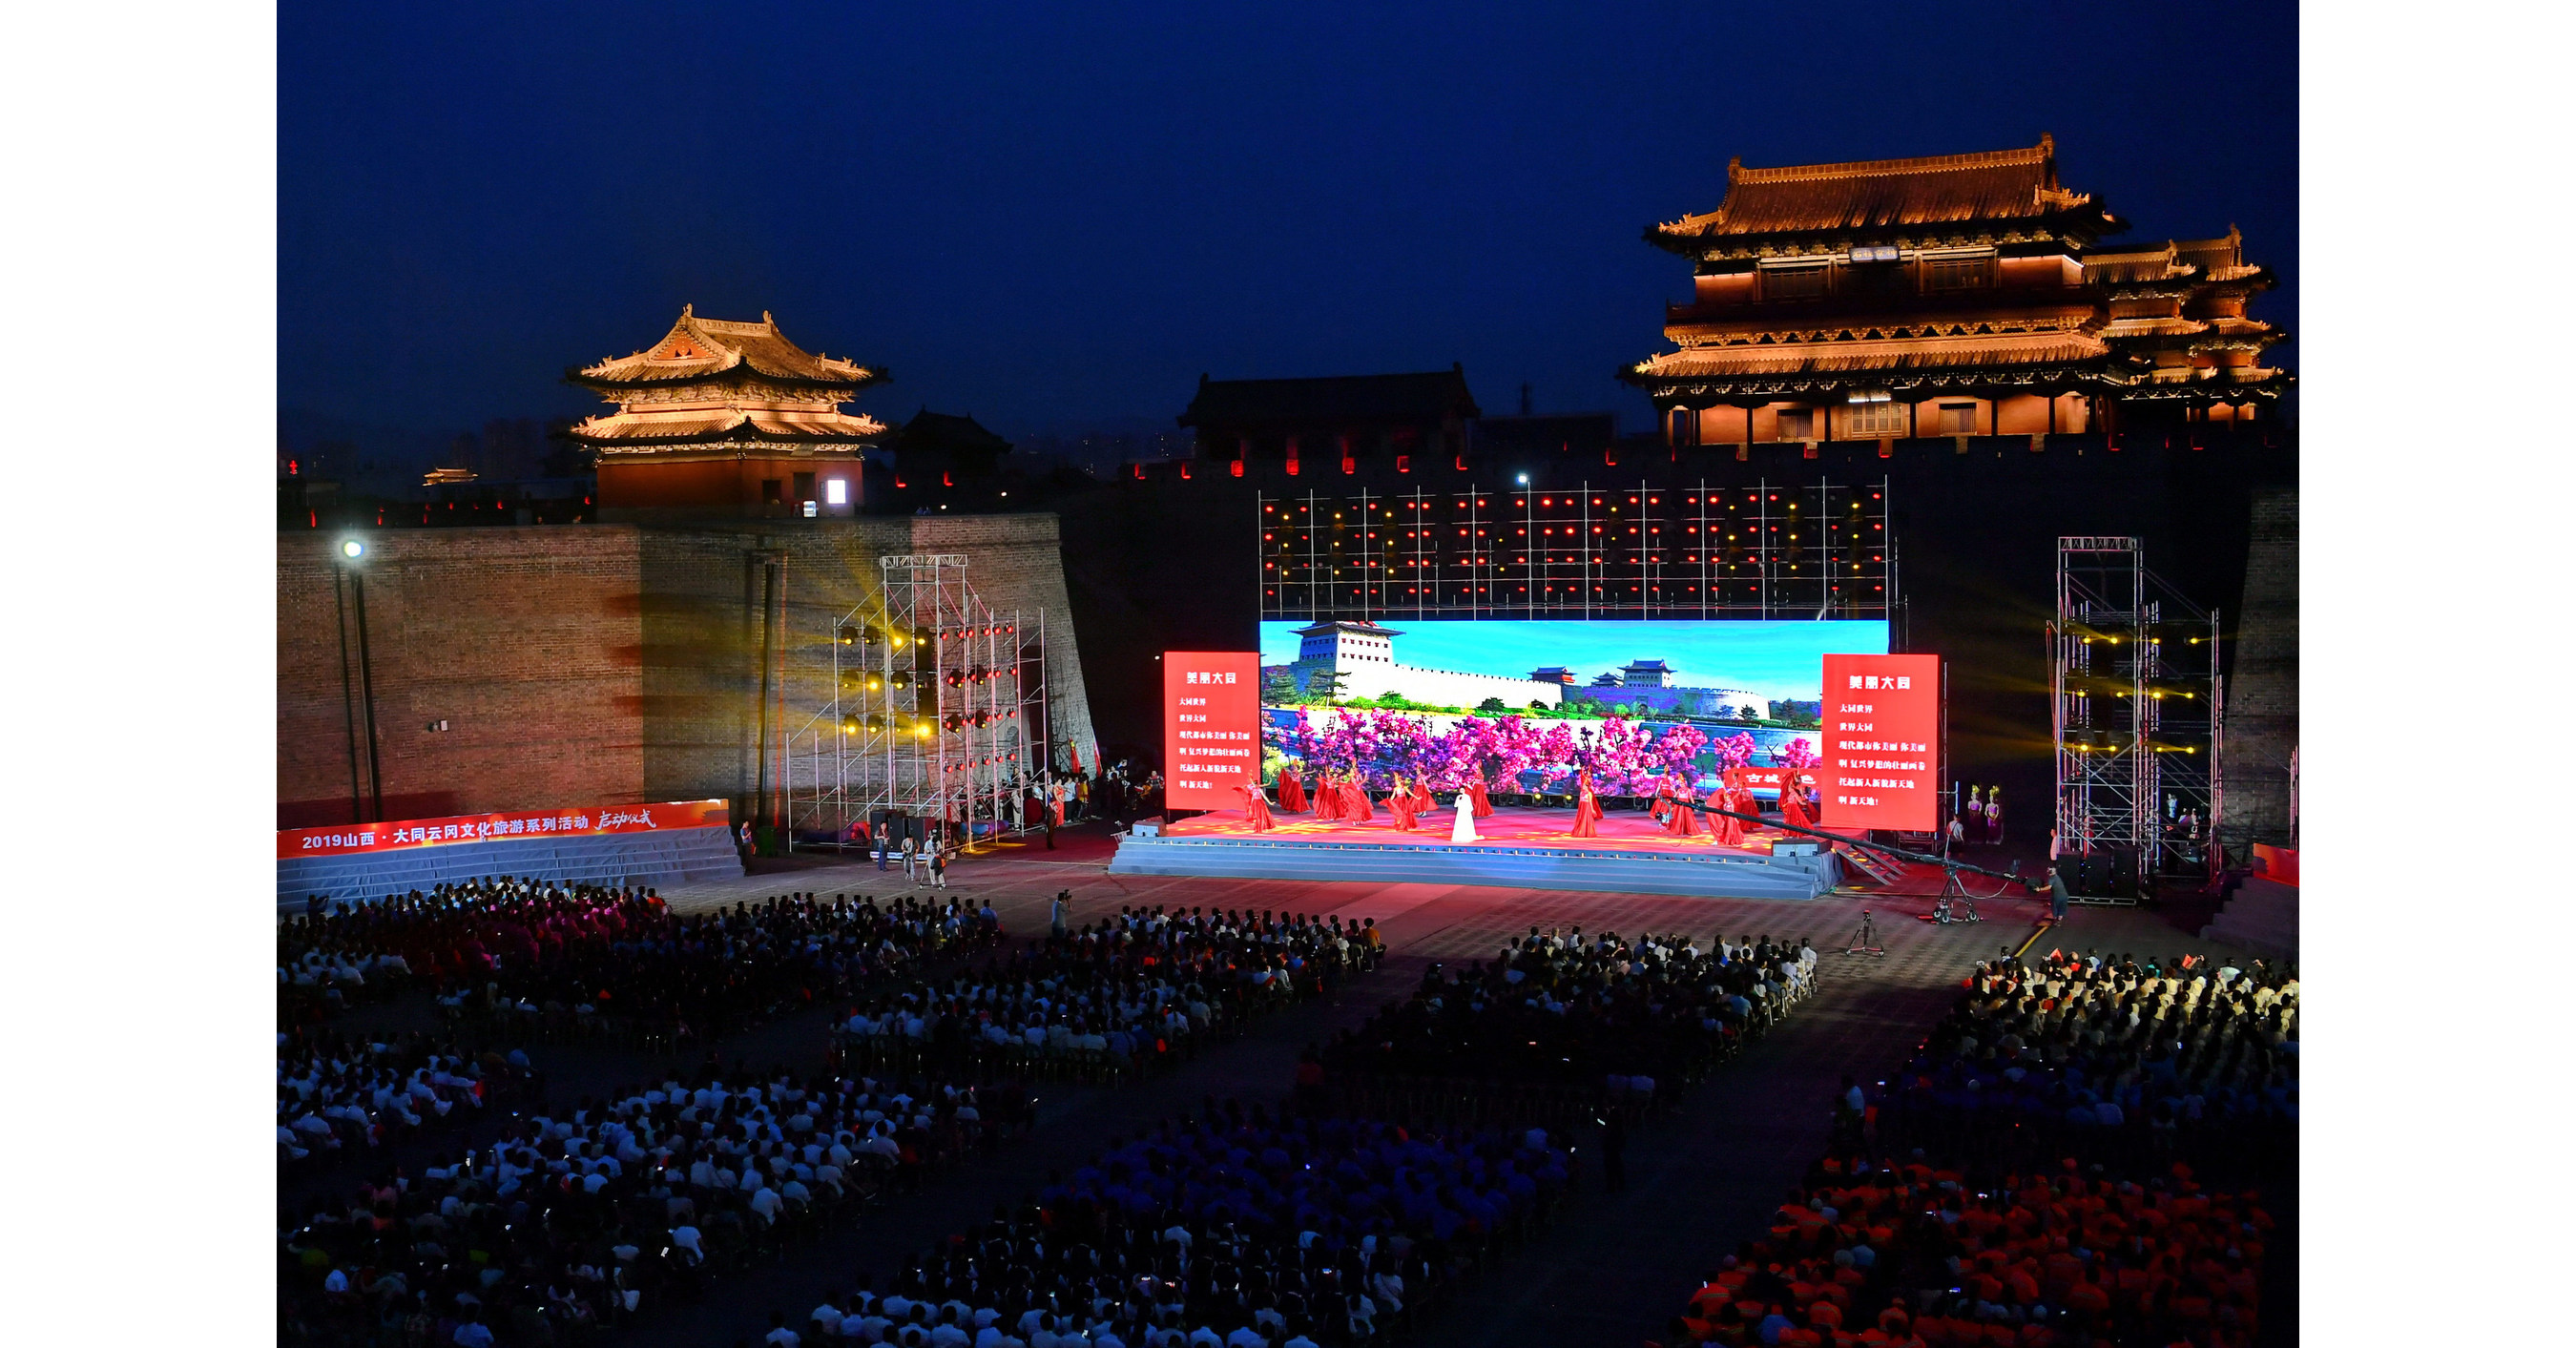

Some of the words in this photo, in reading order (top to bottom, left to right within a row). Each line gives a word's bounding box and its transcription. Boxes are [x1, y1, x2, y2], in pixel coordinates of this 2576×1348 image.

[1186, 671, 1236, 685] 美丽大同
[1849, 674, 1911, 690] 美丽大同
[1178, 697, 1207, 707] 大同世界
[1839, 703, 1873, 714] 大同世界
[1179, 714, 1207, 723] 世界大同
[1839, 722, 1873, 733] 世界大同
[1900, 742, 1926, 753] 你美丽
[1745, 773, 1817, 785] 古城色
[593, 808, 657, 831] 启动仪式
